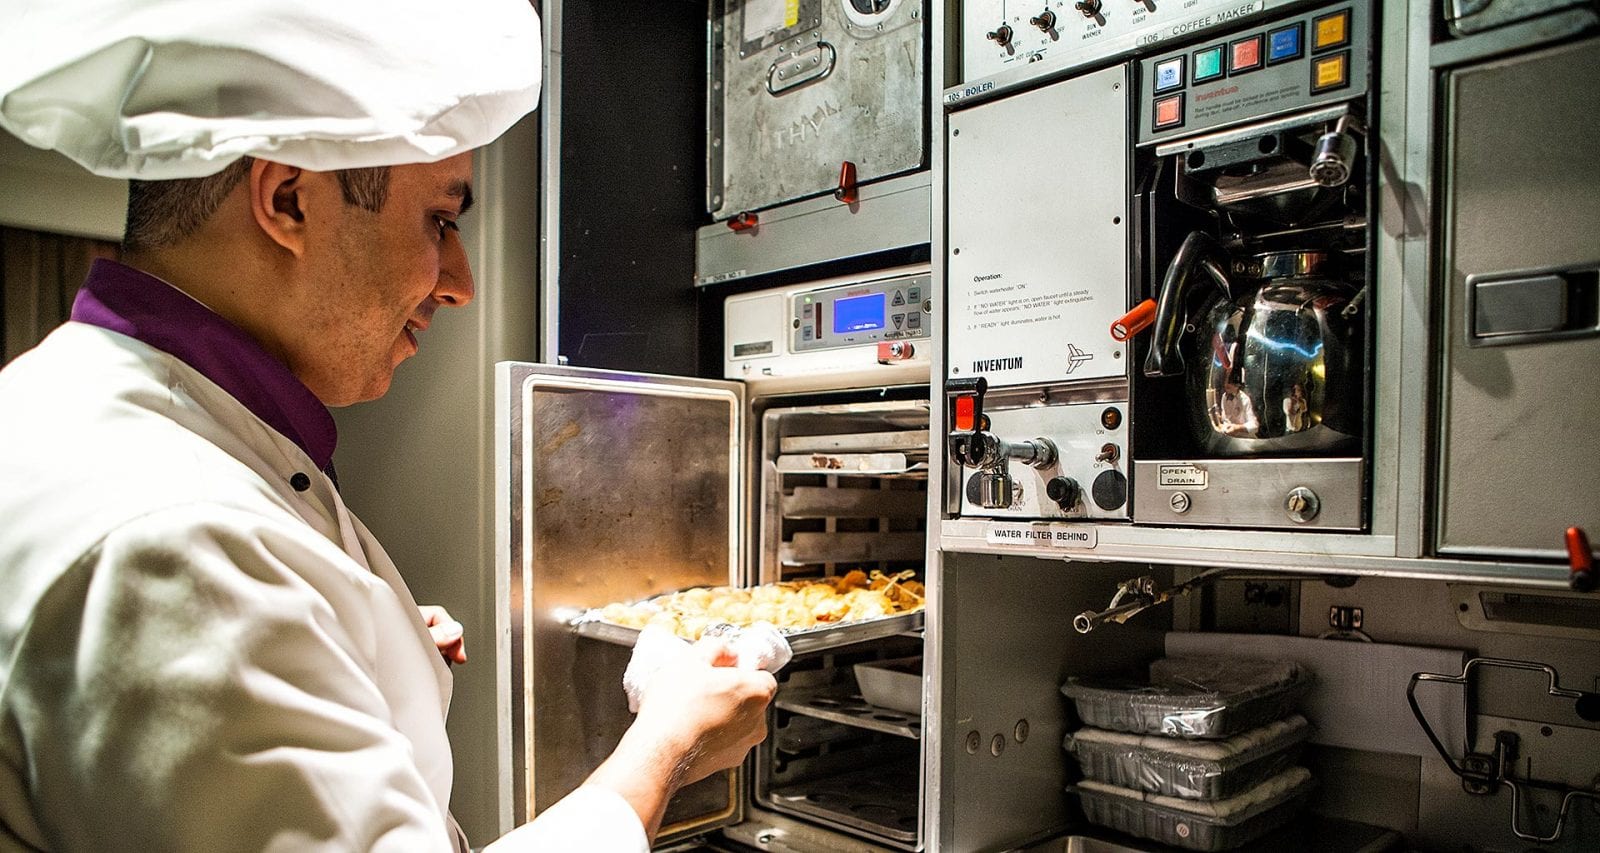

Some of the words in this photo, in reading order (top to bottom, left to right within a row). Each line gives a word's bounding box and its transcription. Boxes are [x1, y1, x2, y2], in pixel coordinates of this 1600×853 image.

[1143, 33, 1158, 45] 106
[1172, 16, 1211, 35] COFFEE
[1217, 4, 1254, 22] MAKER
[949, 92, 960, 101] 105
[966, 82, 993, 96] BOILER
[974, 273, 1002, 283] Operation:
[973, 356, 1022, 373] INVENTUM
[994, 529, 1021, 538] WATER
[1025, 530, 1053, 539] FILTER
[1056, 531, 1089, 541] BEHIND
